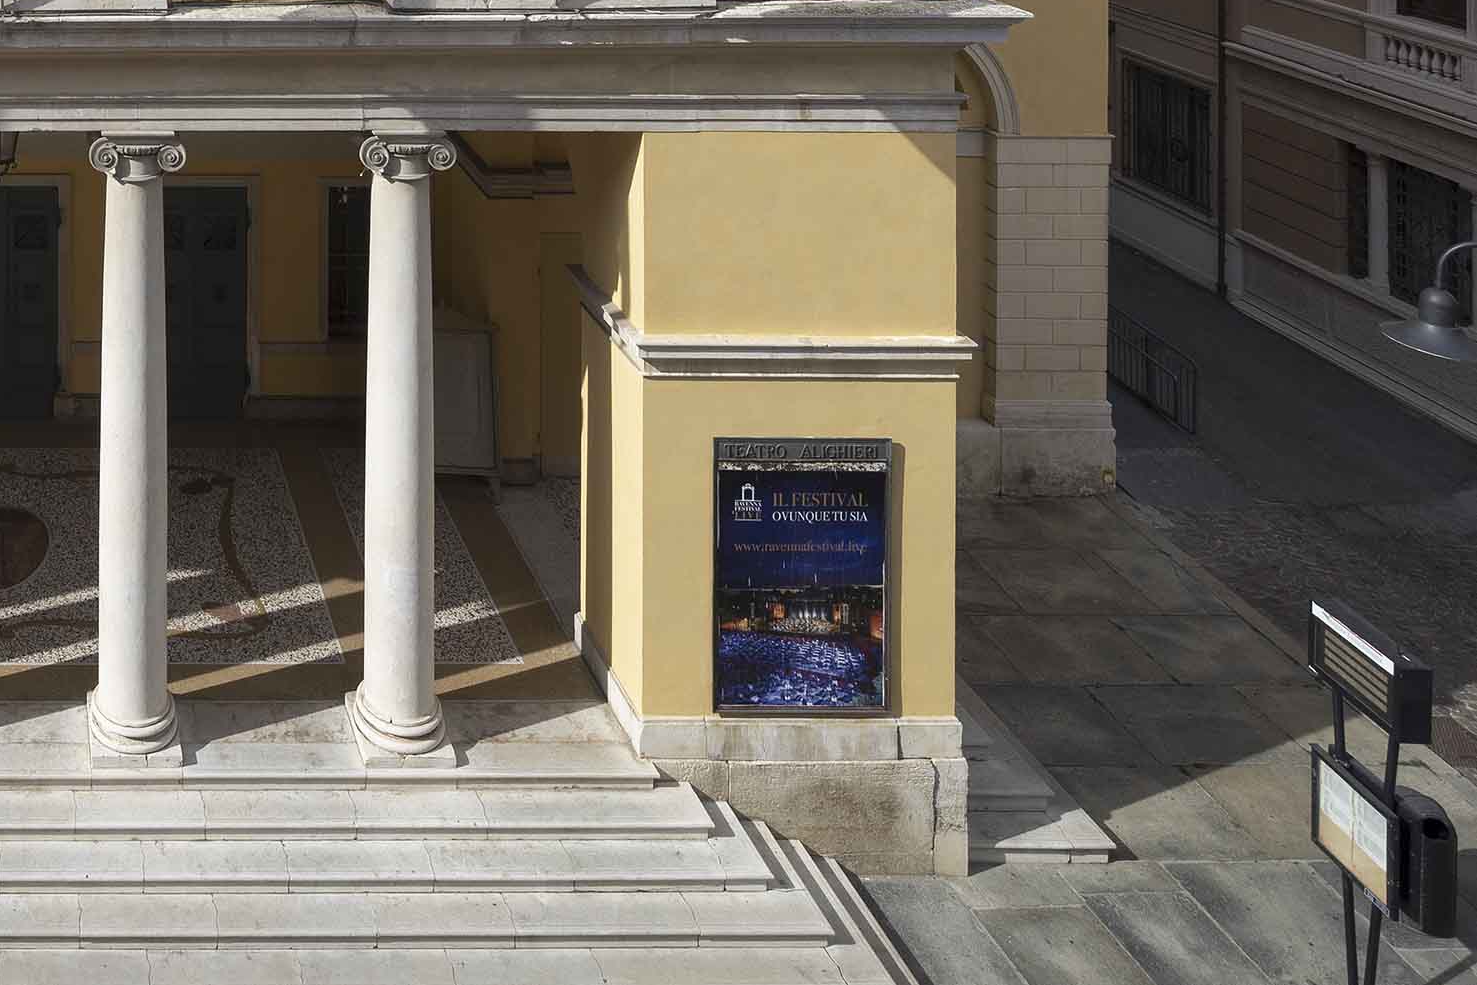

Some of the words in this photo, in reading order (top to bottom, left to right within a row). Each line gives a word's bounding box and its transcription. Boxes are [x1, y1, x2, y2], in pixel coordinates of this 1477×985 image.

[723, 443, 787, 459] TEATRO
[798, 443, 877, 459] ALIGHIERI
[773, 492, 788, 507] IL
[792, 492, 869, 507] FESTIVAL
[772, 511, 830, 524] OVUNQUE
[832, 511, 848, 522] TU
[849, 511, 869, 522] SIA
